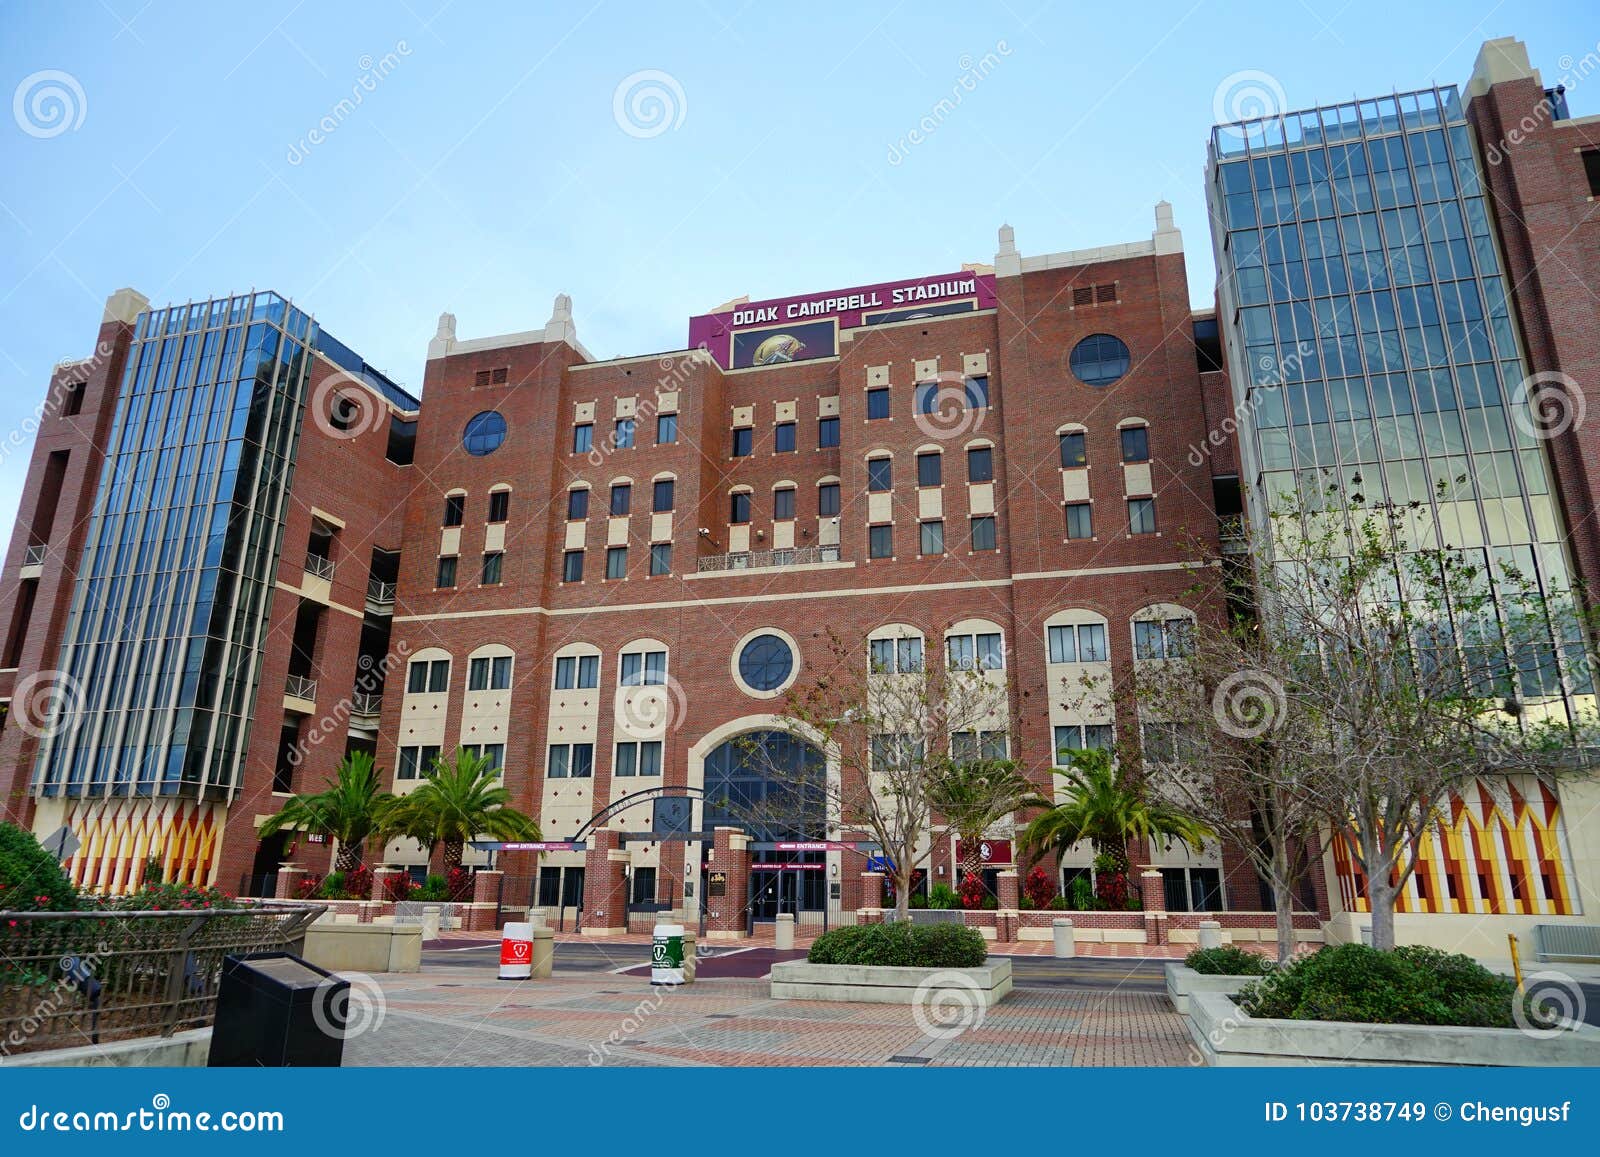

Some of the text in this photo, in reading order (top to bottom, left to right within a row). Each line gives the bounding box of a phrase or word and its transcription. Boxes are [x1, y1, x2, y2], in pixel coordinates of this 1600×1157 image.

[733, 278, 976, 326] DOAK CAMPBELL STADIUM
